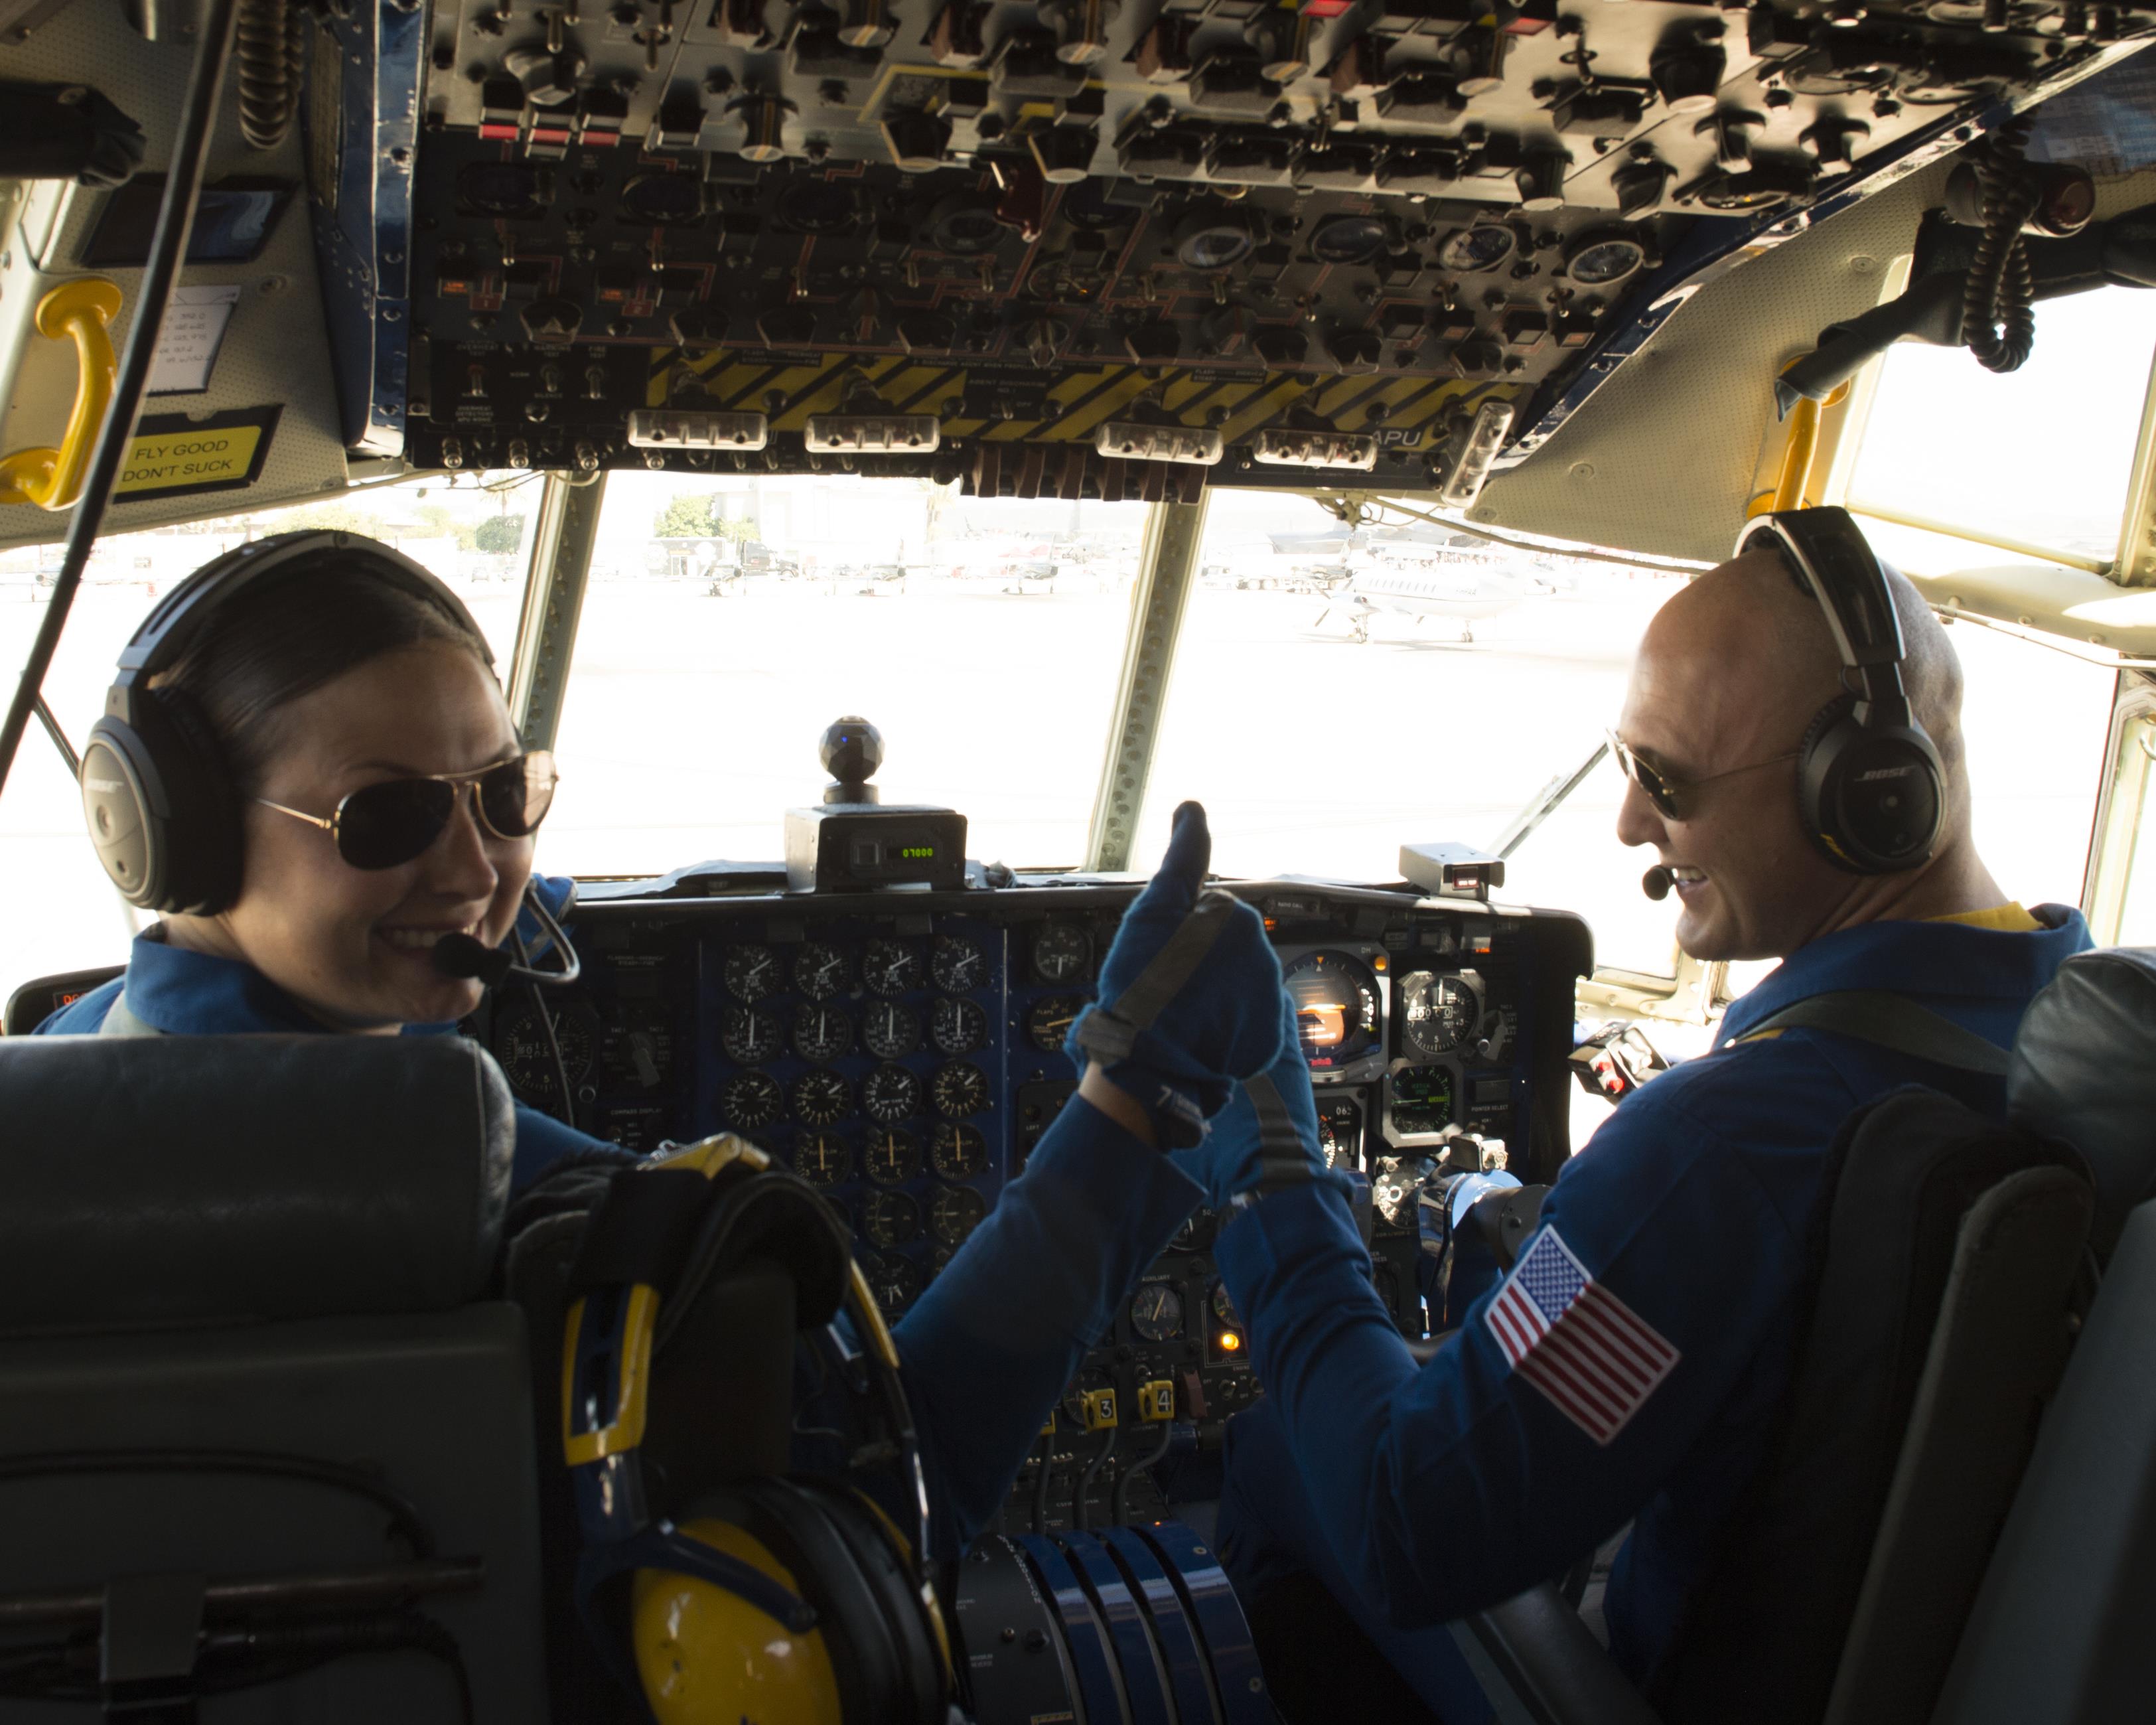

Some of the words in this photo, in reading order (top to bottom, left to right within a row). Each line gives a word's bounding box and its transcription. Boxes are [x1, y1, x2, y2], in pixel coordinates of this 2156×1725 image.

[1372, 430, 1421, 446] APU
[135, 446, 170, 461] FLY
[173, 440, 229, 456] GOOD
[122, 465, 180, 482] DON'T
[182, 459, 234, 475] SUCK
[1856, 766, 1912, 782] BOSE
[903, 848, 933, 858] 07000
[1101, 1399, 1112, 1418] 3
[1157, 1390, 1170, 1412] 4
